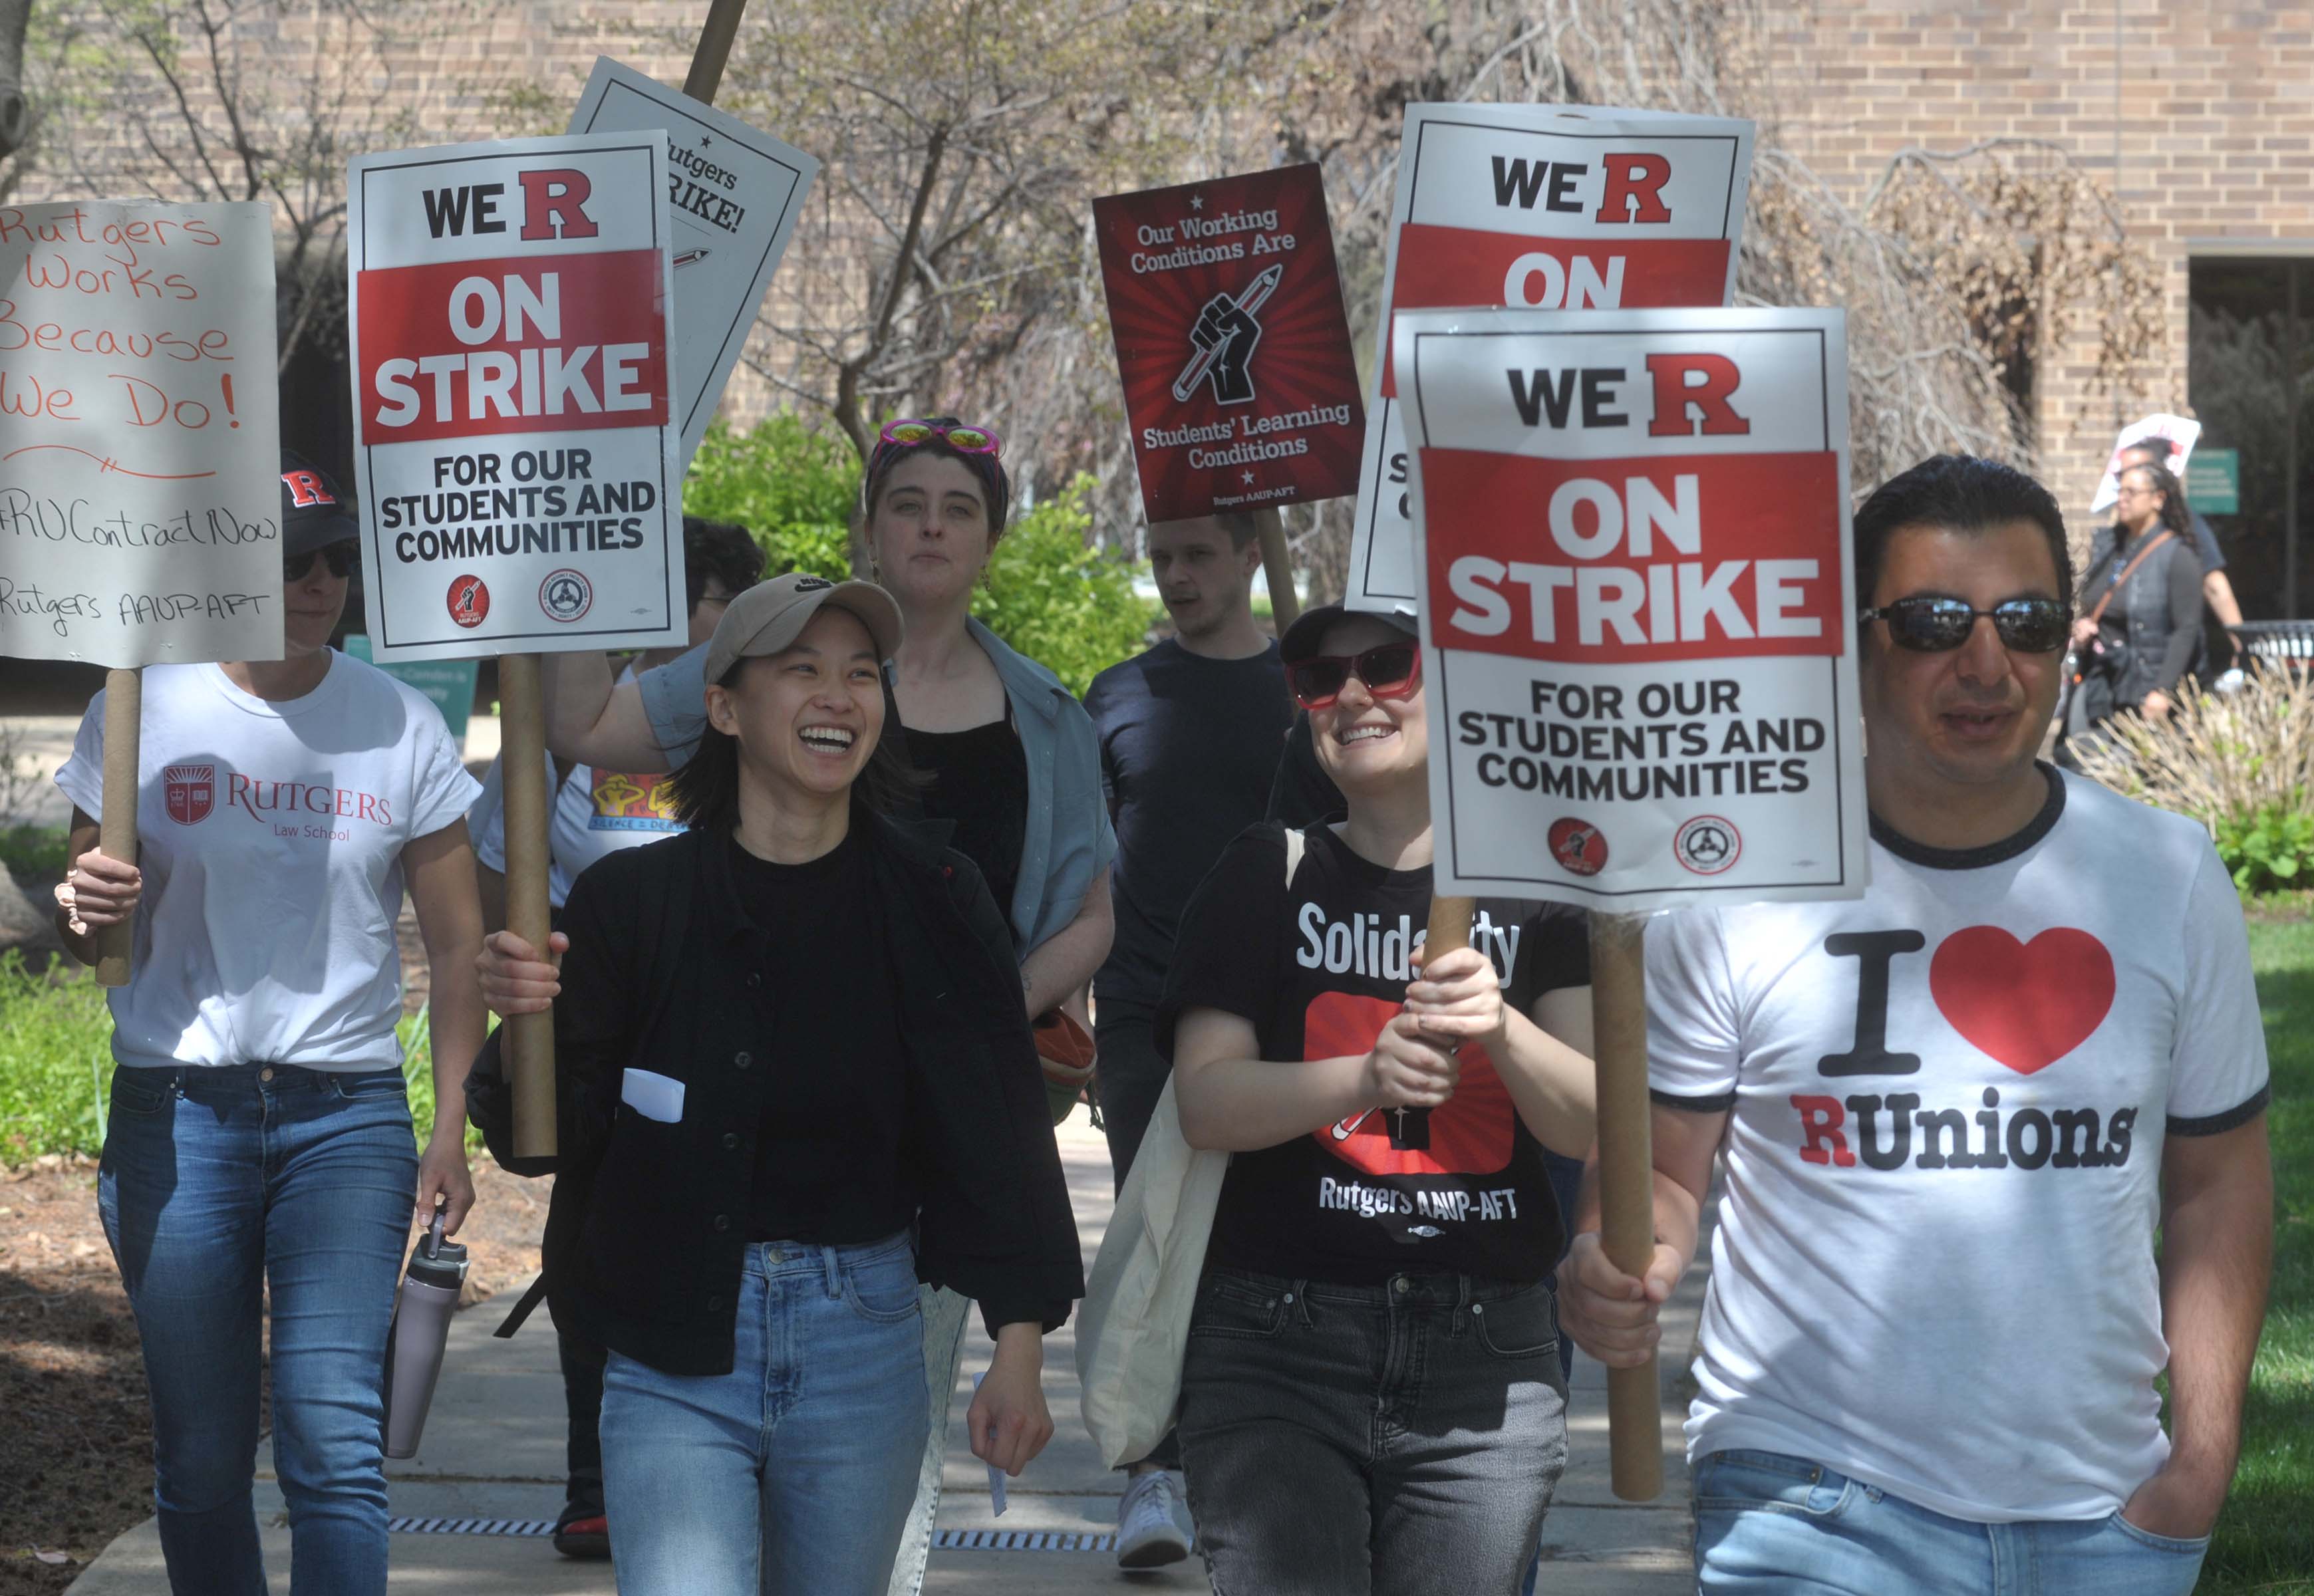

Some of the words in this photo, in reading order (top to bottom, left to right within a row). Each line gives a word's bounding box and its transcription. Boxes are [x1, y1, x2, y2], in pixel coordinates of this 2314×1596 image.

[667, 136, 738, 191] utgers
[1491, 155, 1588, 213] WE
[1595, 152, 1672, 223] R
[422, 182, 506, 239] WE
[518, 168, 599, 241] R
[1137, 225, 1175, 246] Our
[1179, 209, 1277, 239] Working
[0, 207, 221, 267] Rutgers
[1131, 241, 1244, 274] Conditions
[1252, 233, 1296, 255] Are
[26, 254, 198, 300] Works
[1503, 251, 1626, 309] ON
[0, 299, 235, 362] Because
[448, 271, 561, 345] ON
[1, 371, 80, 420] We
[108, 372, 240, 429] Do!
[375, 342, 652, 427] STRIKE
[1507, 368, 1628, 430] WE
[1646, 352, 1751, 438] R
[1143, 417, 1235, 449] Students'
[1240, 404, 1350, 436] Learning
[1189, 437, 1308, 469] Conditions
[281, 470, 336, 508] R
[434, 453, 501, 488] FOR
[511, 448, 591, 482] OUR
[381, 485, 567, 529] STUDENTS
[575, 481, 656, 516] AND
[1213, 495, 1245, 506] Rutgers
[1246, 485, 1296, 502] AAUP-AFT
[1548, 473, 1701, 560] ON
[395, 517, 645, 563] COMMUNITIES
[0, 577, 102, 637] Rutgers
[119, 593, 271, 626] AAUP-AFT
[1448, 555, 1822, 646] STRIKE
[1530, 679, 1625, 720] FOR
[1638, 678, 1741, 718] OUR
[1458, 710, 1709, 761] STUDENTS
[1720, 718, 1826, 755] AND
[226, 772, 393, 826] RUTGERS
[1477, 752, 1809, 802] COMMUNITIES
[273, 824, 299, 837] Law
[304, 825, 350, 842] School
[1817, 928, 1926, 1077] I
[1789, 1086, 2138, 1172] RUnions
[1319, 1176, 1413, 1218] Rutgers
[1416, 1188, 1517, 1222] AAUP-AFT
